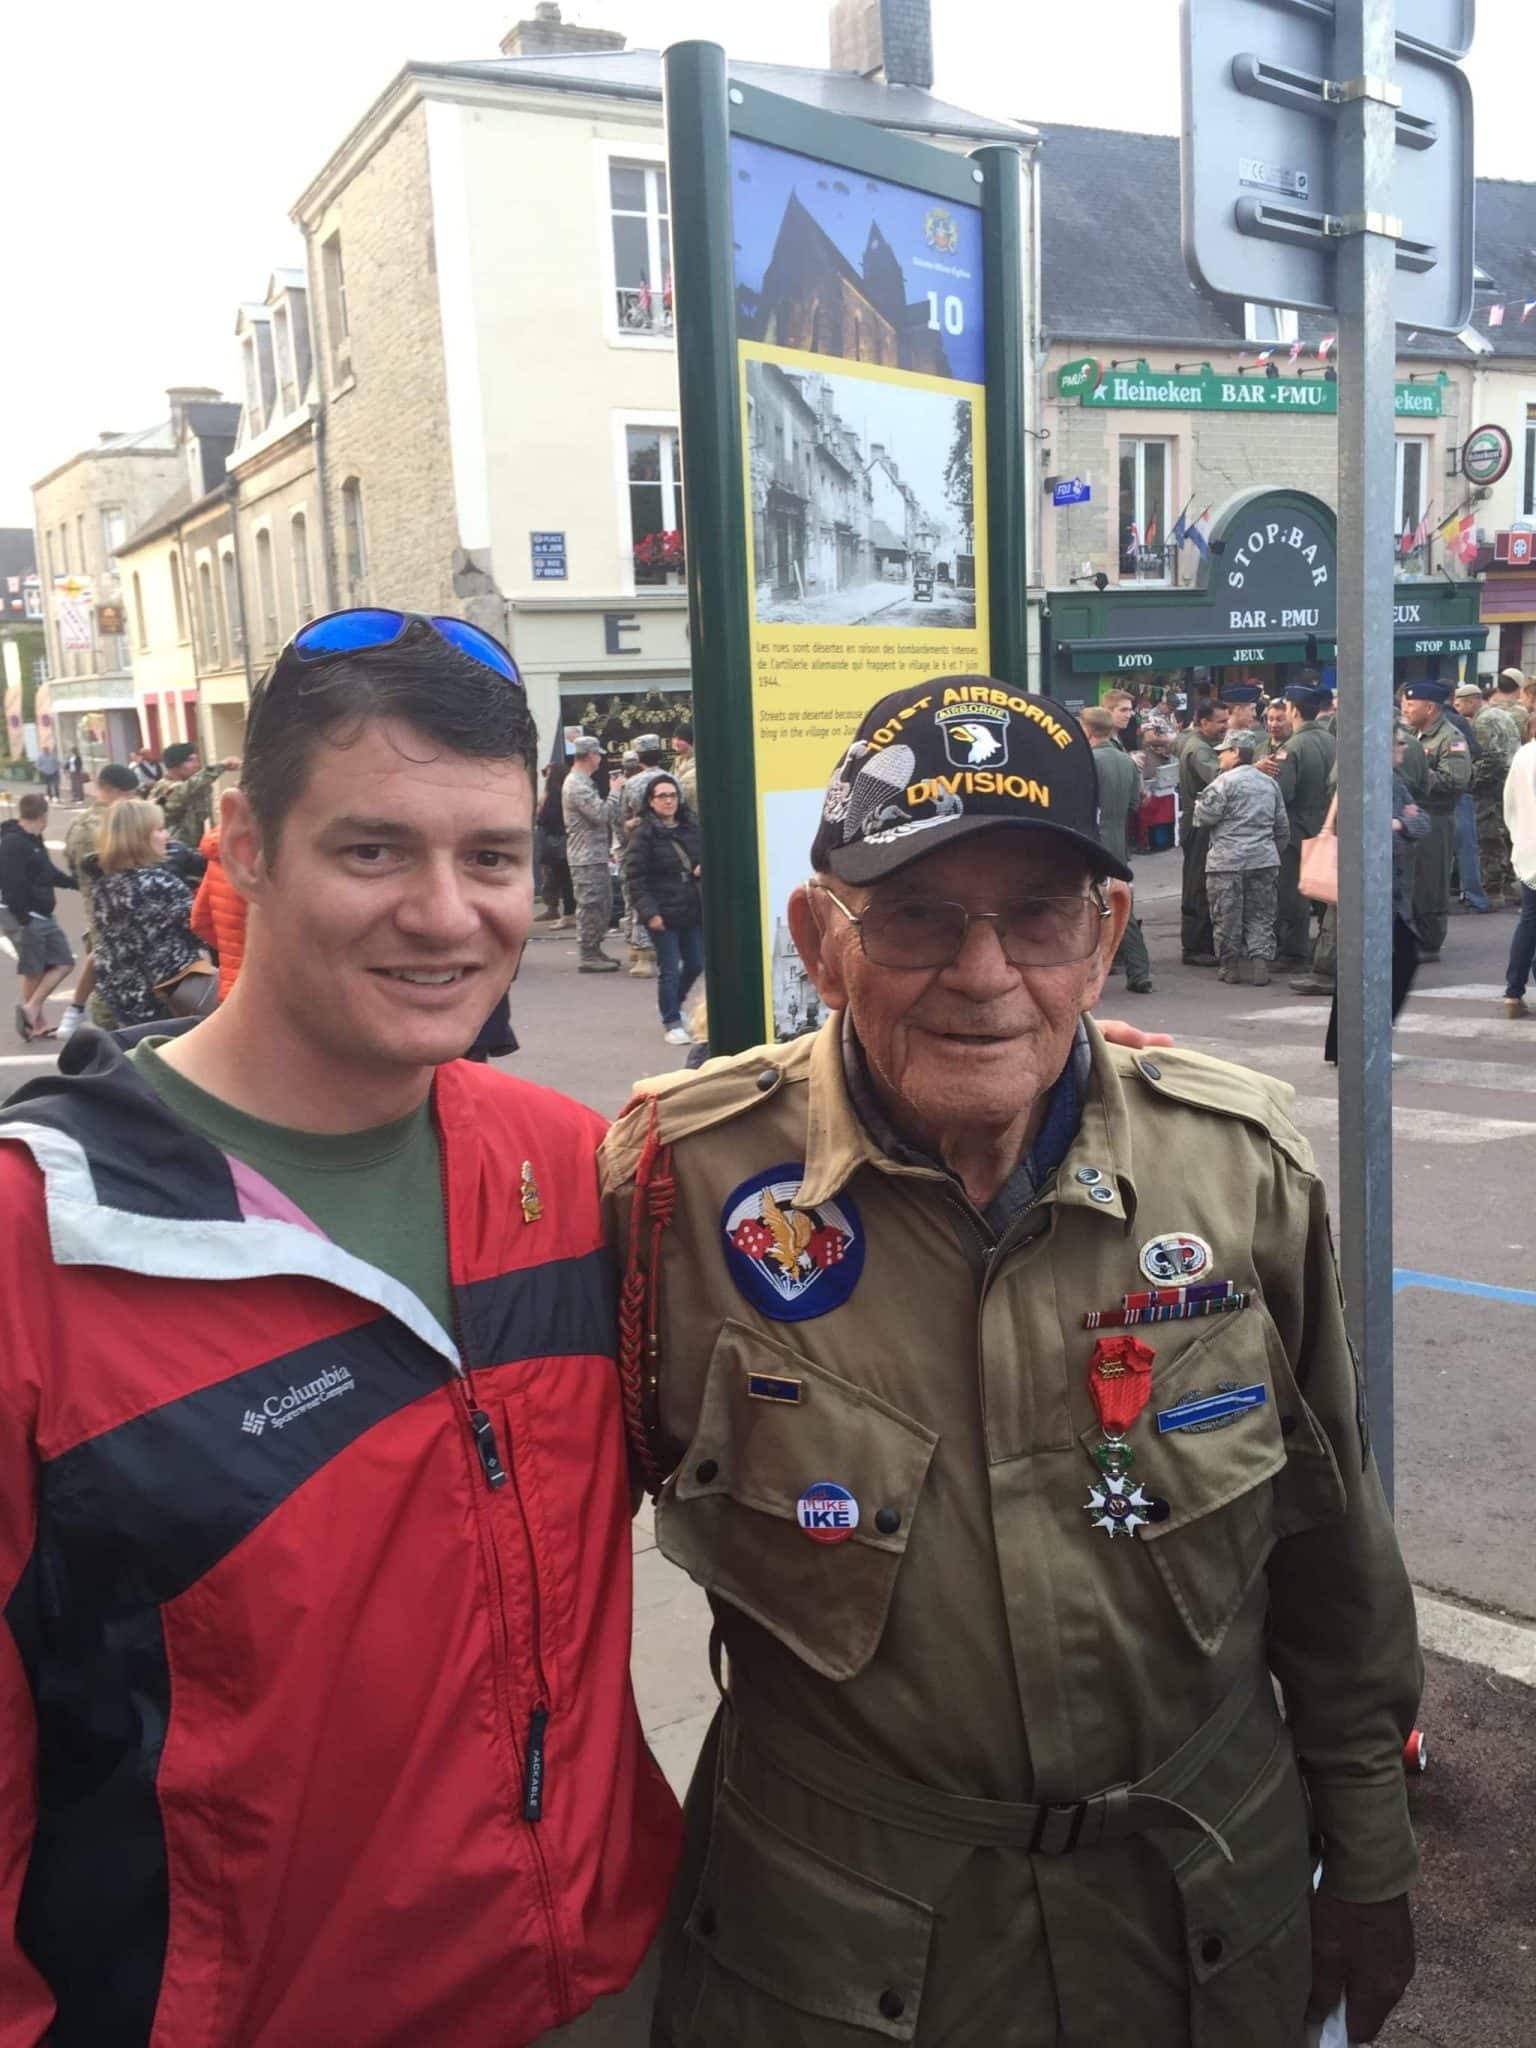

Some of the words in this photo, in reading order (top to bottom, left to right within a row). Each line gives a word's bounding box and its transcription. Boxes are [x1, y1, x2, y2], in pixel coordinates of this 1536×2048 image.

[927, 291, 964, 336] 10
[1062, 374, 1084, 388] PMU
[1114, 378, 1203, 403] Heineken
[1395, 390, 1433, 411] eken
[1229, 611, 1267, 629] BAR
[1281, 609, 1320, 628] PMU
[1393, 605, 1421, 622] EUX
[1415, 641, 1444, 653] STOP
[1449, 639, 1472, 652] BAR
[1118, 654, 1153, 668] LOTO
[1232, 649, 1265, 662] JEUX
[866, 696, 933, 753] 101ST
[943, 685, 1074, 751] AIRBORNE
[938, 704, 1004, 719] AIRBORNE
[906, 771, 1051, 809] DIVISION
[263, 1365, 352, 1417] Columbia
[812, 1500, 849, 1511] LIKE
[804, 1511, 851, 1527] IKE
[529, 1749, 541, 1807] PACKABLE
